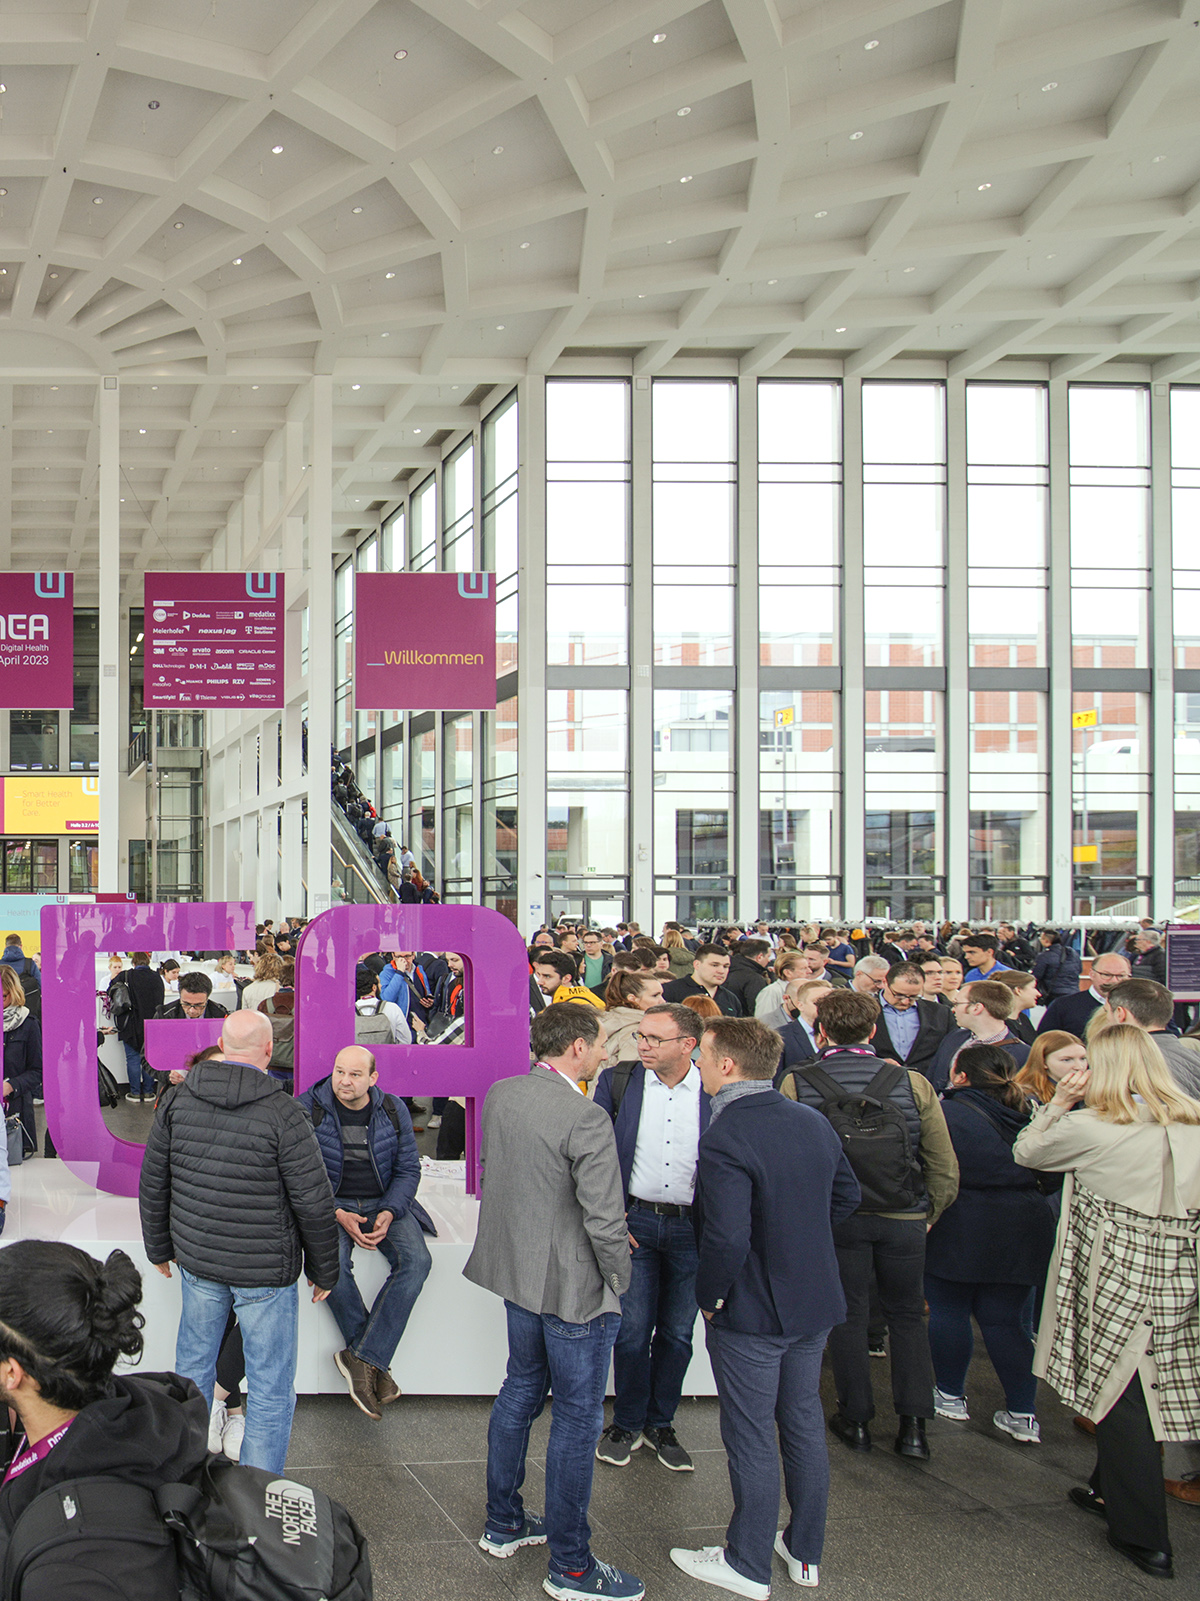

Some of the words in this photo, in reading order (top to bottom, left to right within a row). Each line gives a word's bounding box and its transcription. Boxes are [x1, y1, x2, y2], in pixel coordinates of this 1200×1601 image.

[0, 644, 24, 653] Digital
[25, 644, 49, 652] Health
[22, 655, 49, 665] 2023
[47, 790, 73, 798] Health
[22, 799, 33, 807] for
[36, 799, 61, 807] Better
[22, 808, 41, 816] Care.
[265, 1492, 282, 1519] THE
[282, 1496, 301, 1546] NORTH
[299, 1499, 318, 1537] FACE
